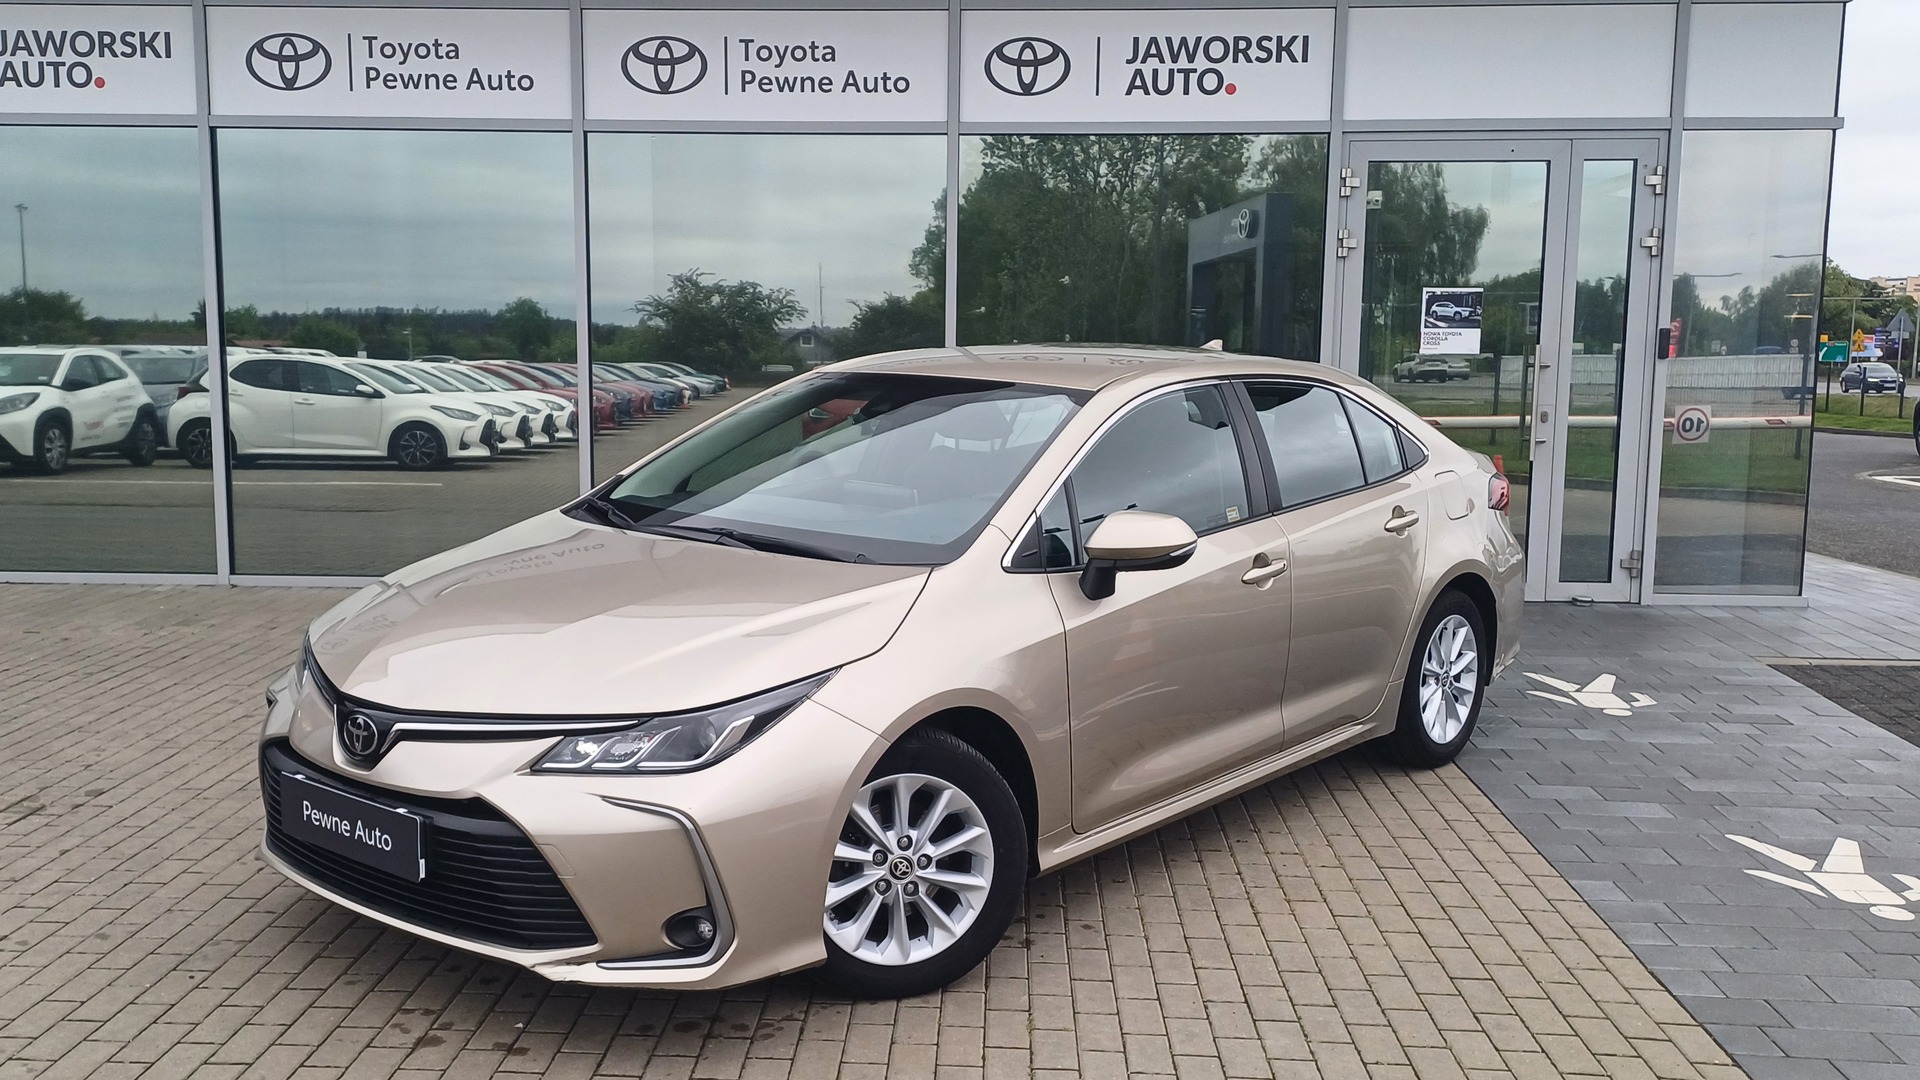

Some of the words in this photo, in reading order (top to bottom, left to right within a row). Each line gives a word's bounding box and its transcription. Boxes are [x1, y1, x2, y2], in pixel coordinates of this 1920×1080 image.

[0, 29, 172, 59] JAWORSKI
[361, 35, 460, 64] Toyota
[738, 38, 836, 67] Toyota
[1125, 34, 1310, 65] JAWORSKI
[365, 67, 458, 91] Pewne
[465, 67, 535, 92] Auto
[740, 69, 834, 94] Pewne
[840, 69, 910, 94] Auto
[302, 800, 351, 837] Pewne
[354, 819, 392, 851] Auto
